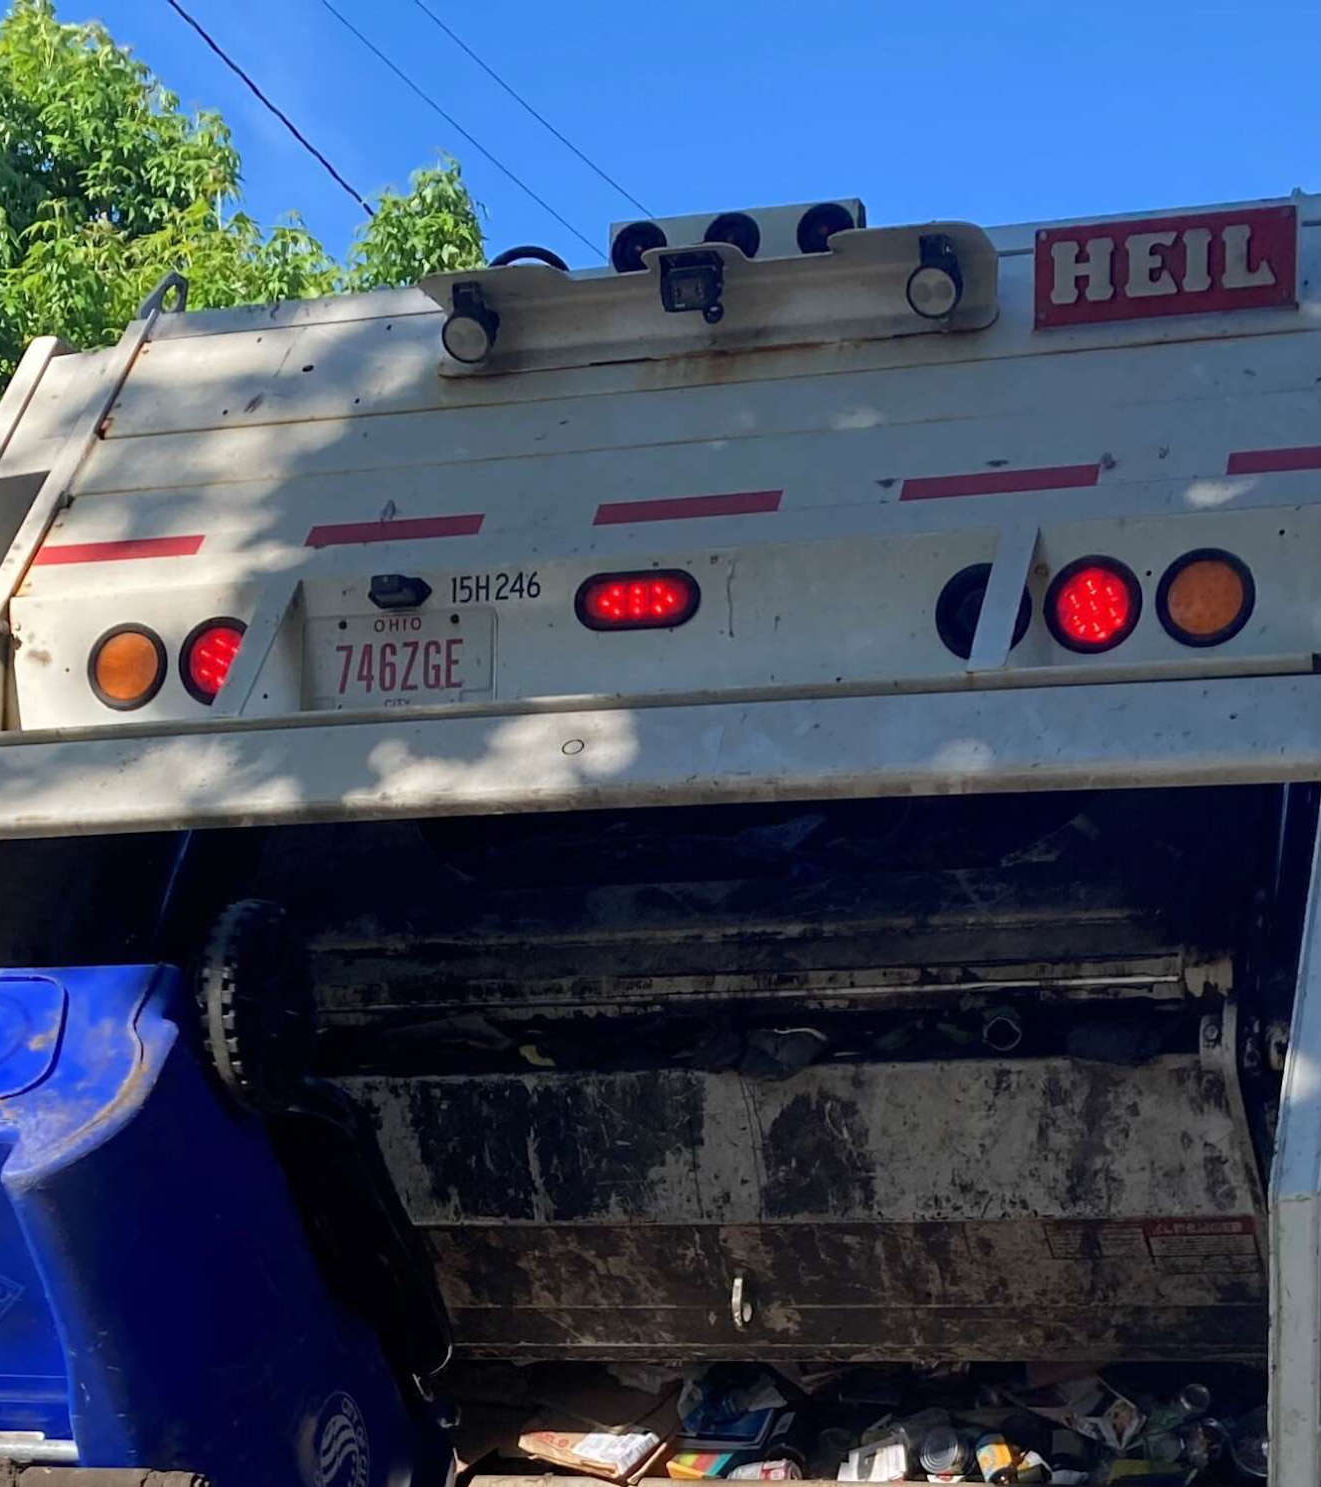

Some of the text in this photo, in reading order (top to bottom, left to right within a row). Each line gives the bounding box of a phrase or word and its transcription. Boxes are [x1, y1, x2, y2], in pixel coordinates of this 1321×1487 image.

[1050, 224, 1276, 305] HEIL
[451, 571, 541, 603] 15H246
[374, 617, 422, 632] OHIO
[336, 638, 464, 694] 746ZGE
